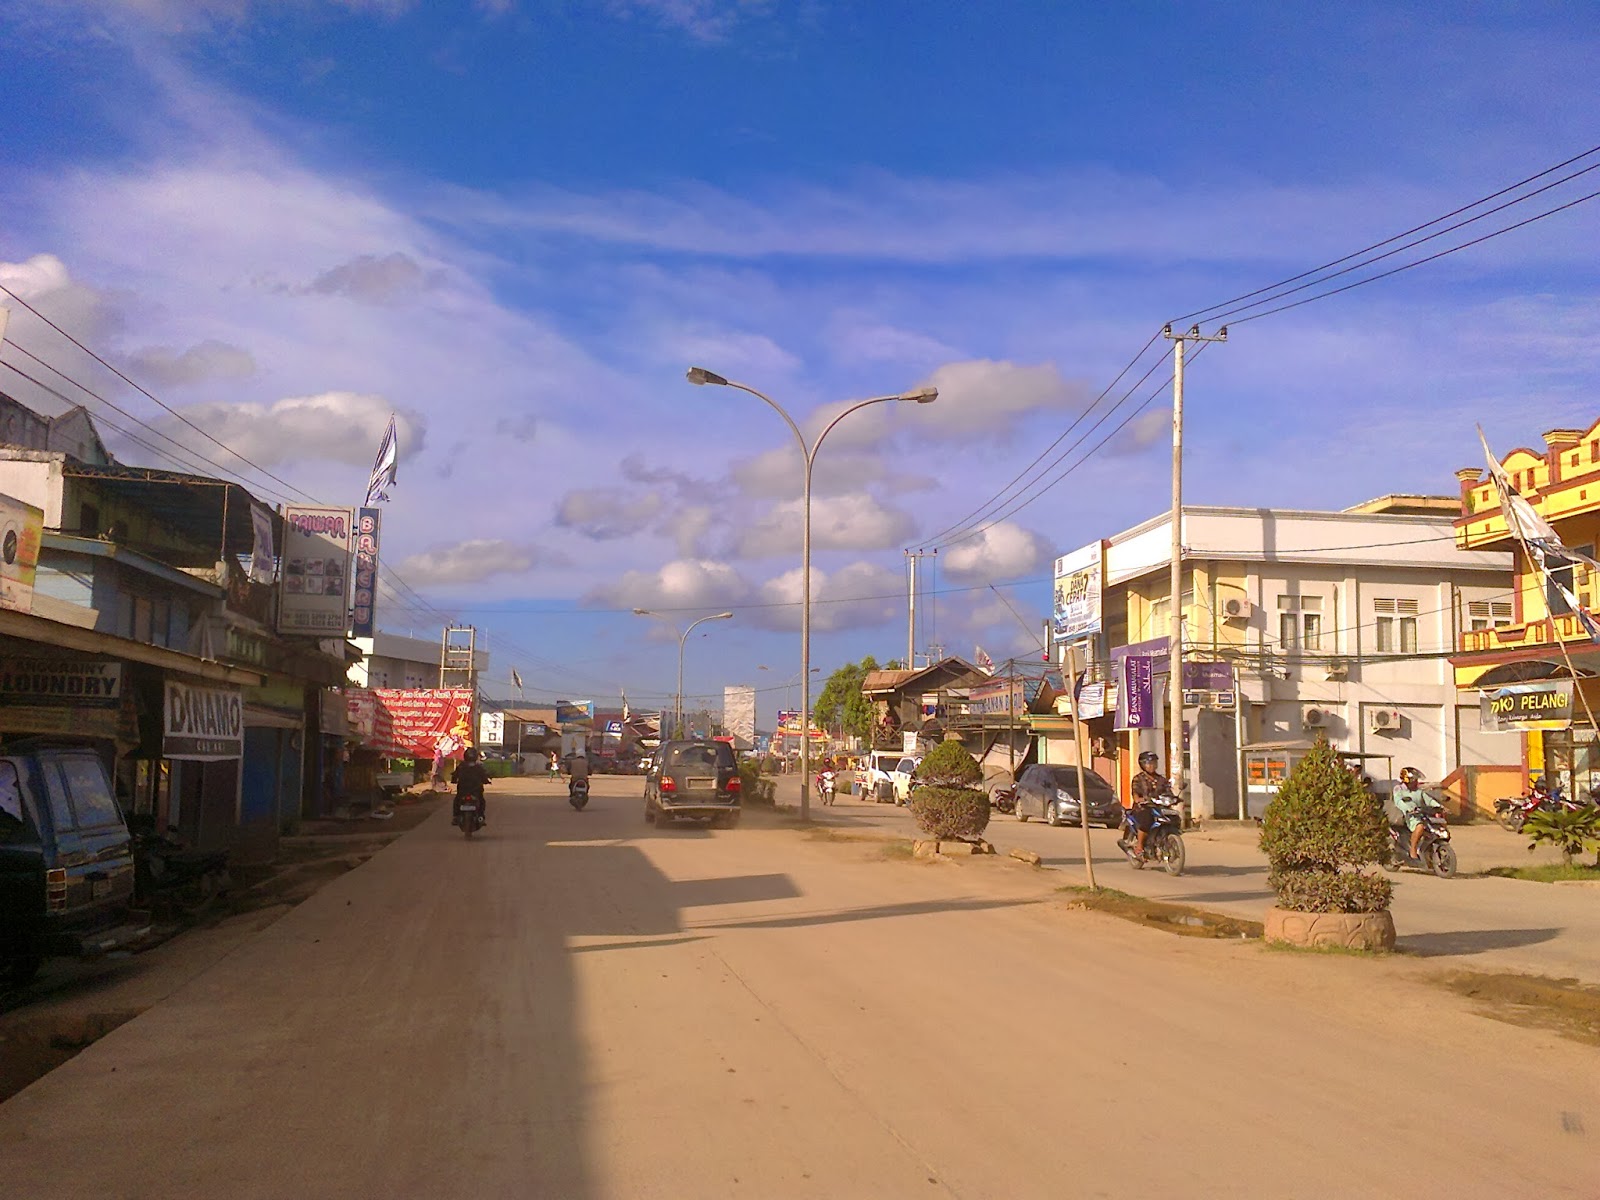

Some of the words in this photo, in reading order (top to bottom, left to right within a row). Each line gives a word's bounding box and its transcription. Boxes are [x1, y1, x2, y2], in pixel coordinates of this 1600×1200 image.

[290, 514, 346, 539] TAIWAN
[354, 516, 377, 625] BAKERY
[1070, 578, 1084, 593] DANA
[1130, 660, 1138, 695] MUAMALAT
[169, 687, 240, 736] DINAMO
[1130, 695, 1138, 713] BANK
[1521, 692, 1568, 710] PELANGI
